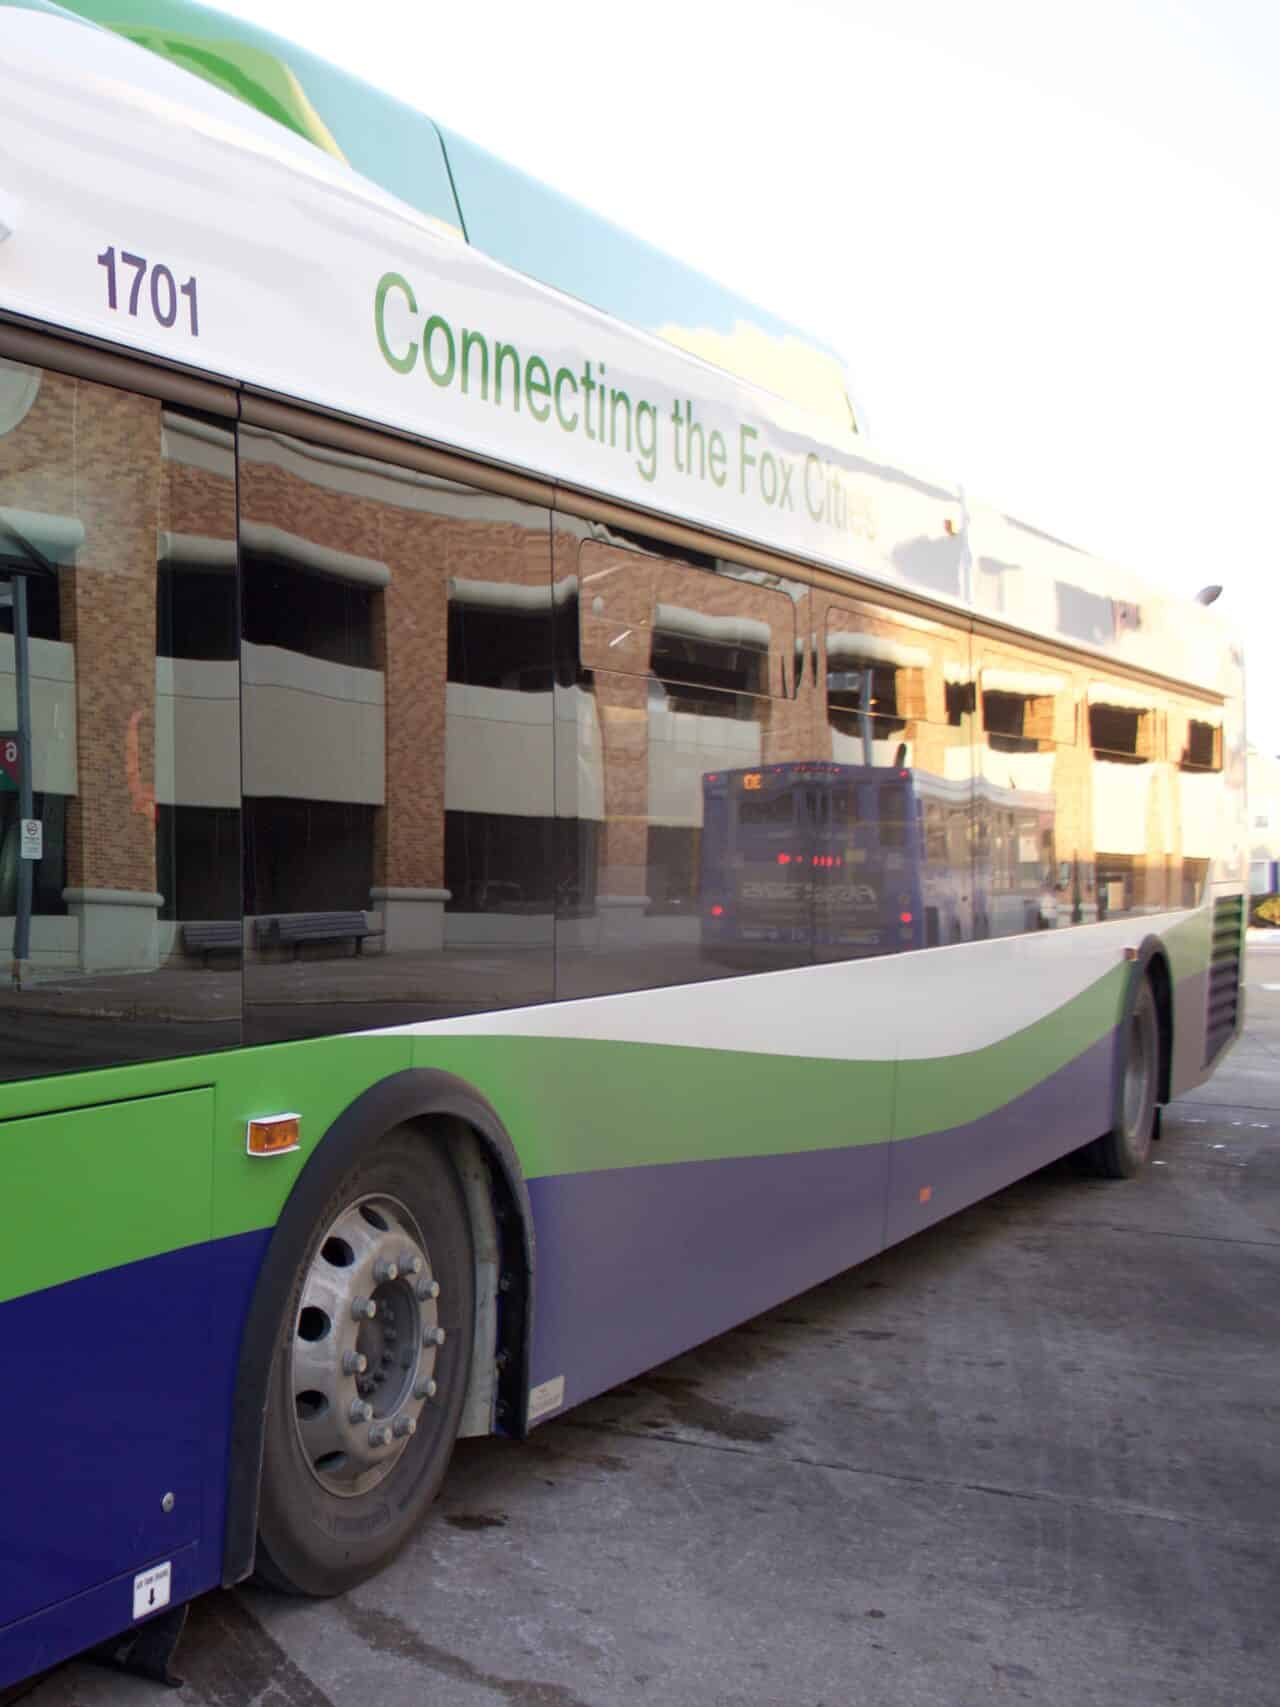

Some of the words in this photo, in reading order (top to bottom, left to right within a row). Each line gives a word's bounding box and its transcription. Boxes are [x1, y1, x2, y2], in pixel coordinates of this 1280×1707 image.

[97, 245, 199, 337] 1701
[374, 271, 657, 483] Connecting
[670, 399, 728, 489] the
[738, 423, 794, 513] Fox
